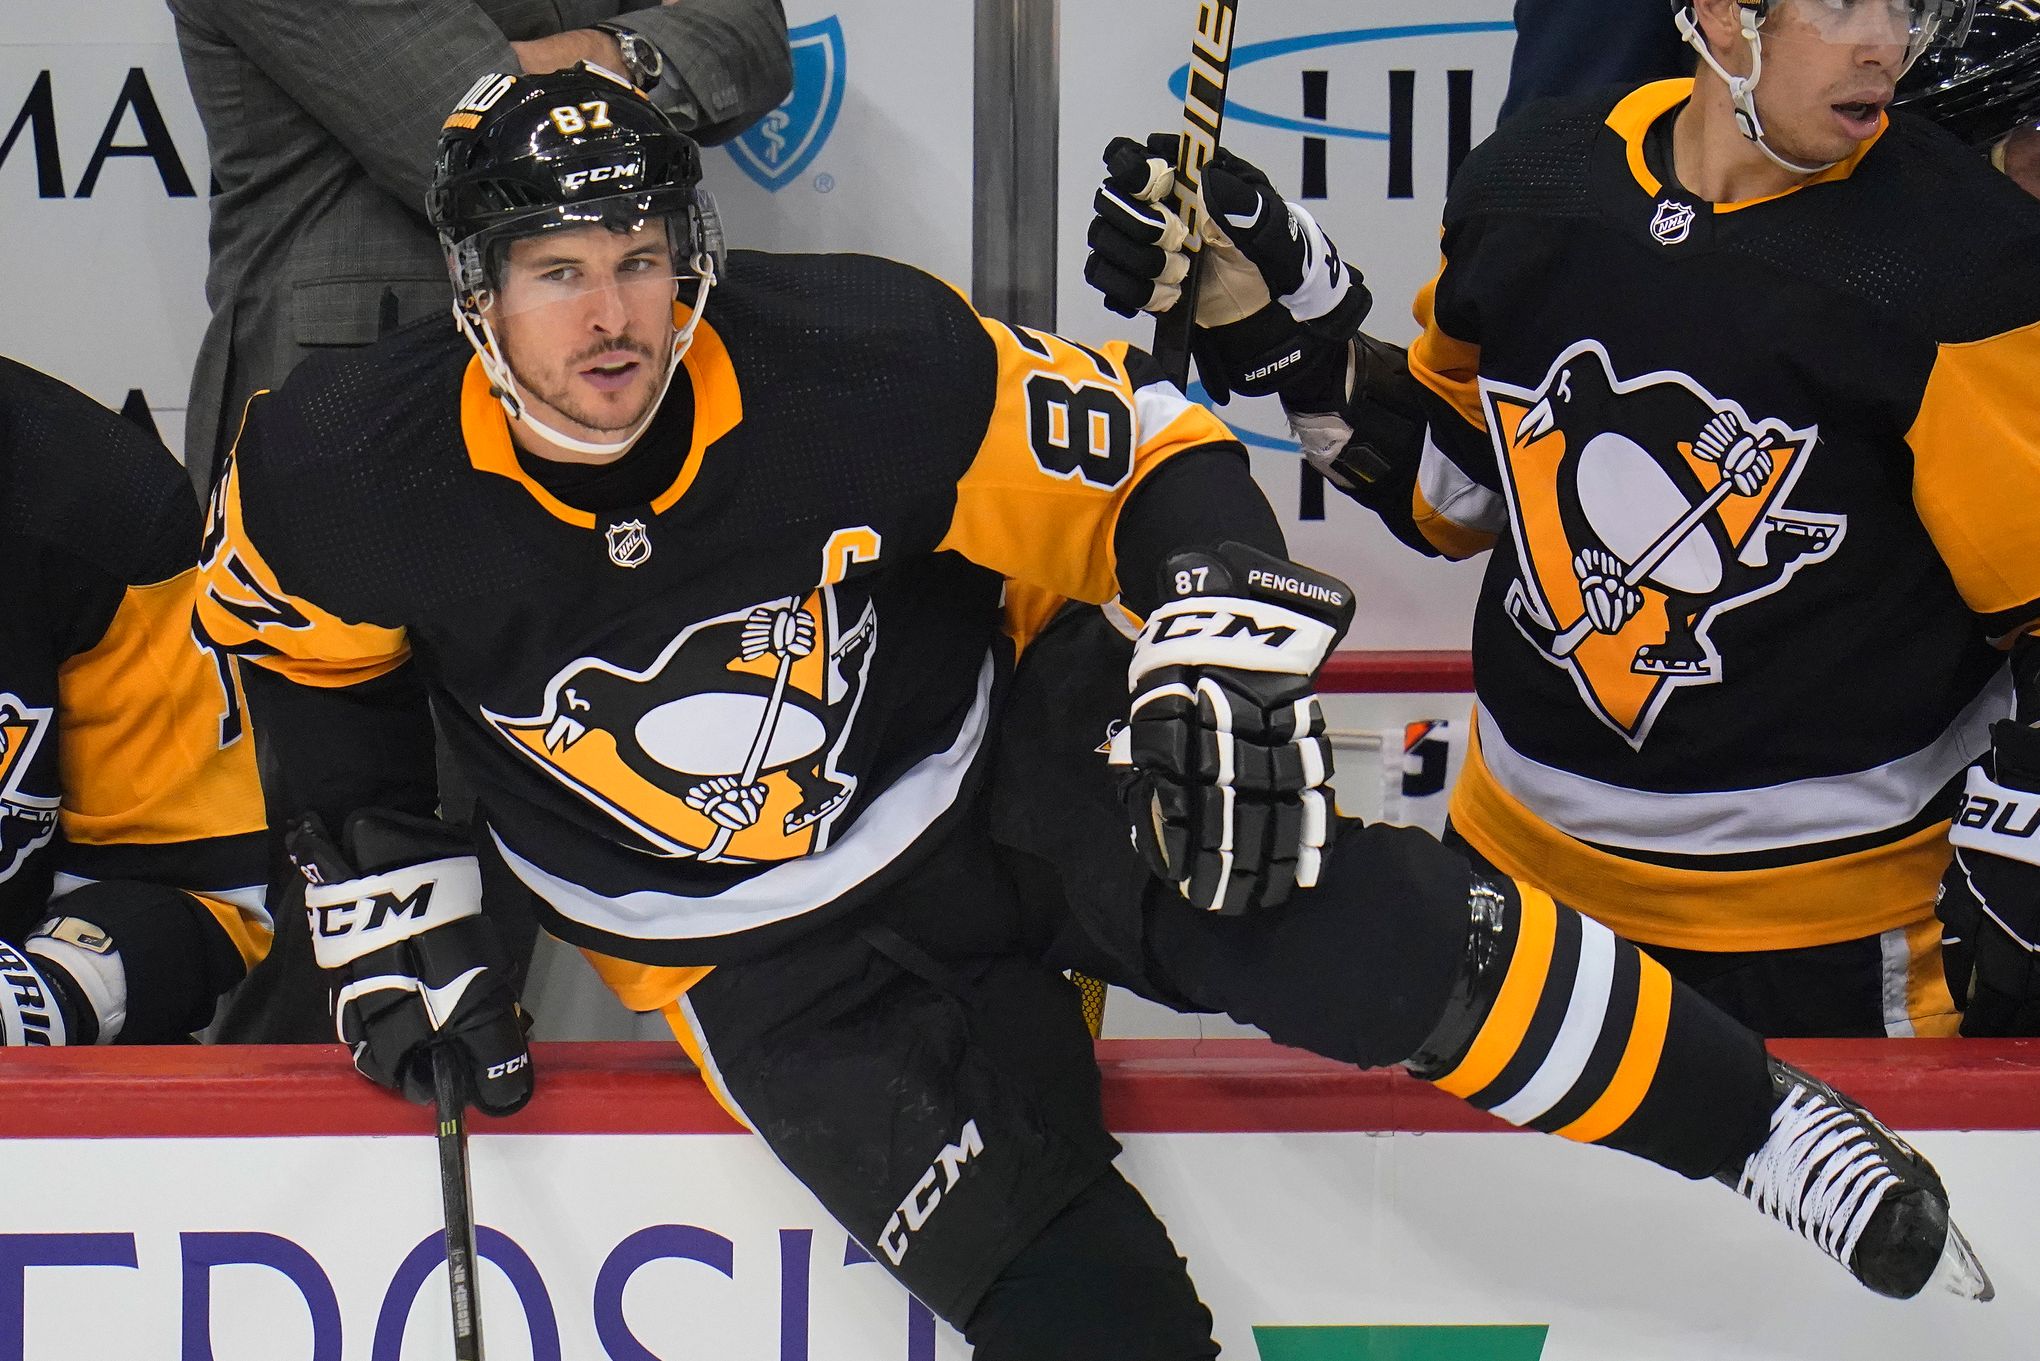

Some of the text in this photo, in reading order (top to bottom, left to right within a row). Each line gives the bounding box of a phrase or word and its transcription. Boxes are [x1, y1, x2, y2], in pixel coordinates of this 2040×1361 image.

[549, 100, 614, 136] 87
[562, 163, 638, 188] CCM
[814, 525, 882, 589] C
[1174, 565, 1209, 596] 87
[1247, 569, 1343, 607] PENGUINS
[1134, 611, 1299, 658] CM
[306, 879, 438, 939] CM
[876, 1118, 985, 1267] CCM
